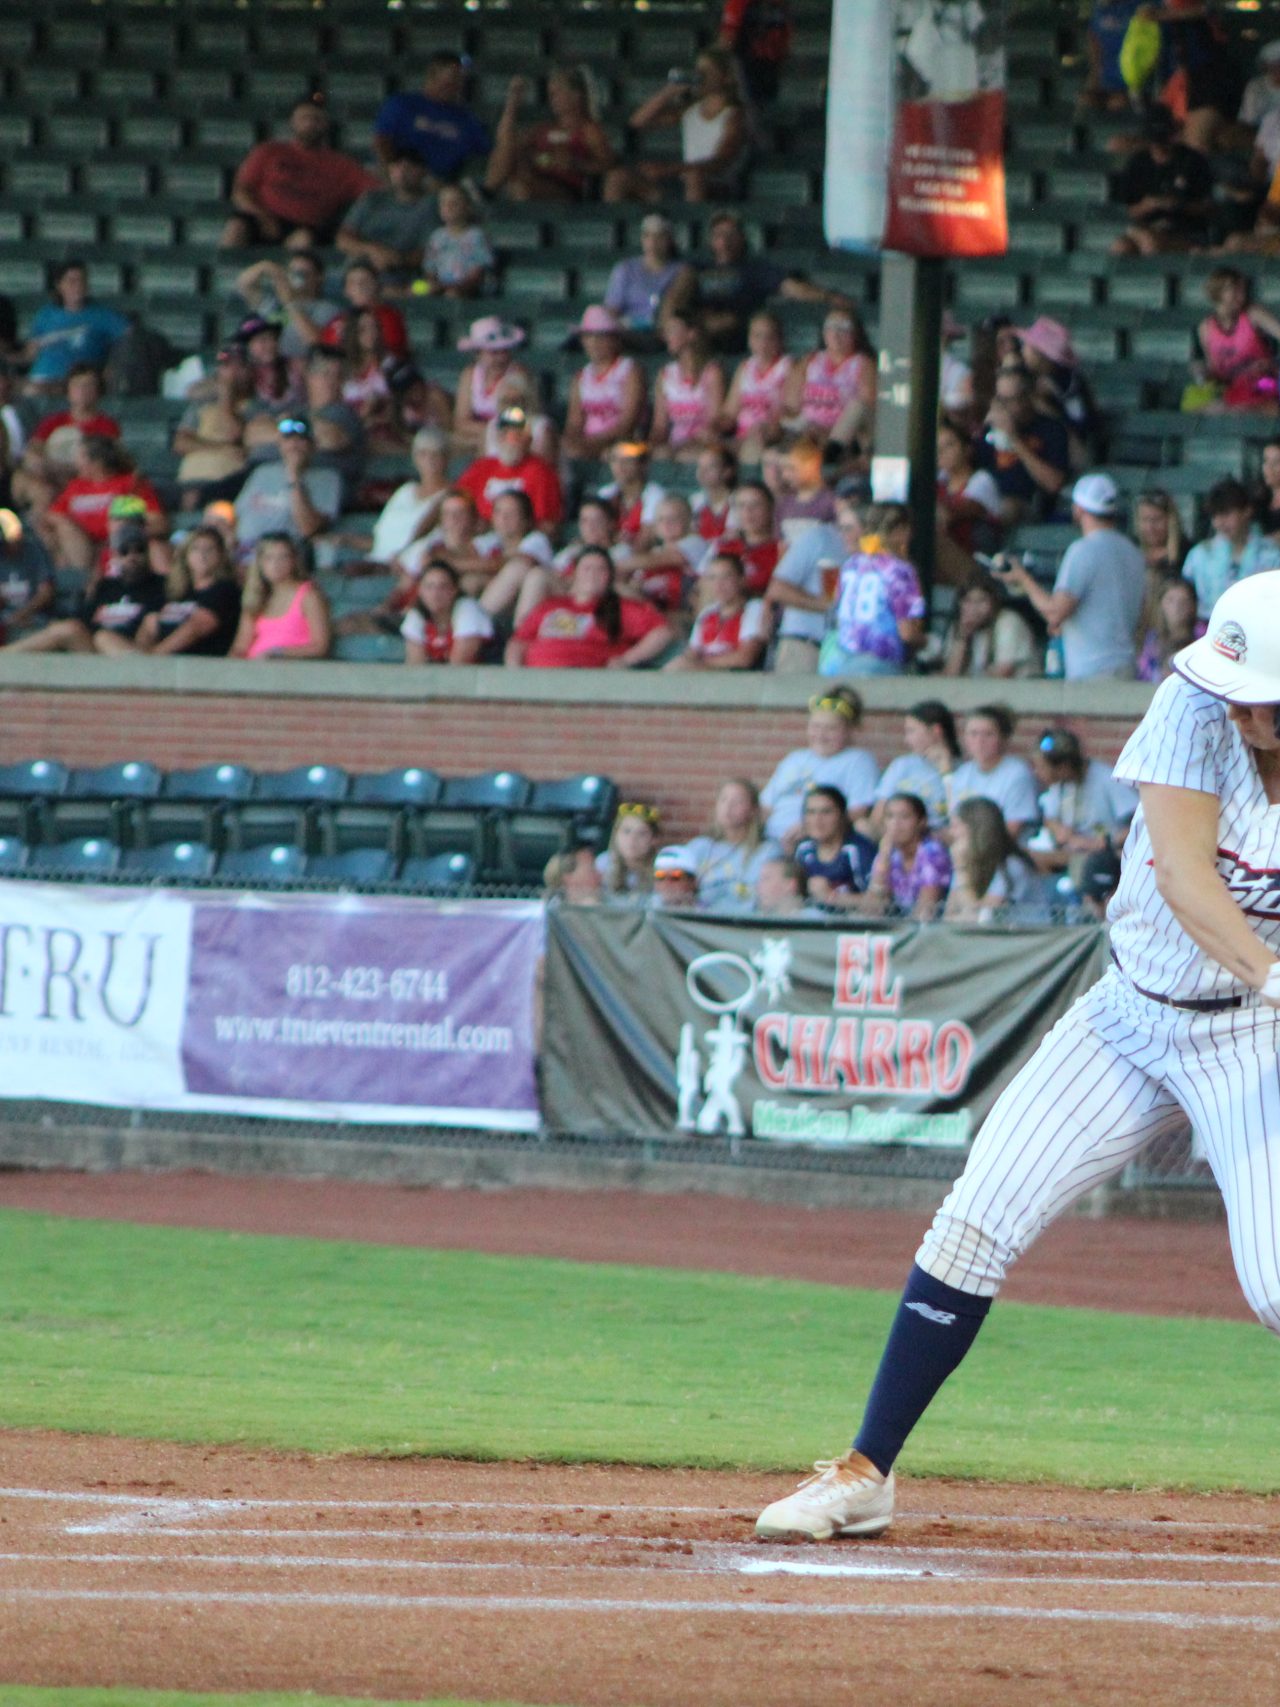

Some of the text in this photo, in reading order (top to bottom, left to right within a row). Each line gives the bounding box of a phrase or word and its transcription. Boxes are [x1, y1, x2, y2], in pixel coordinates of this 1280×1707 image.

[285, 963, 450, 1000] 812-423-6744
[834, 934, 904, 1012] EL
[214, 1015, 513, 1050] www.trueventrental.com
[754, 1012, 975, 1096] CHARRO
